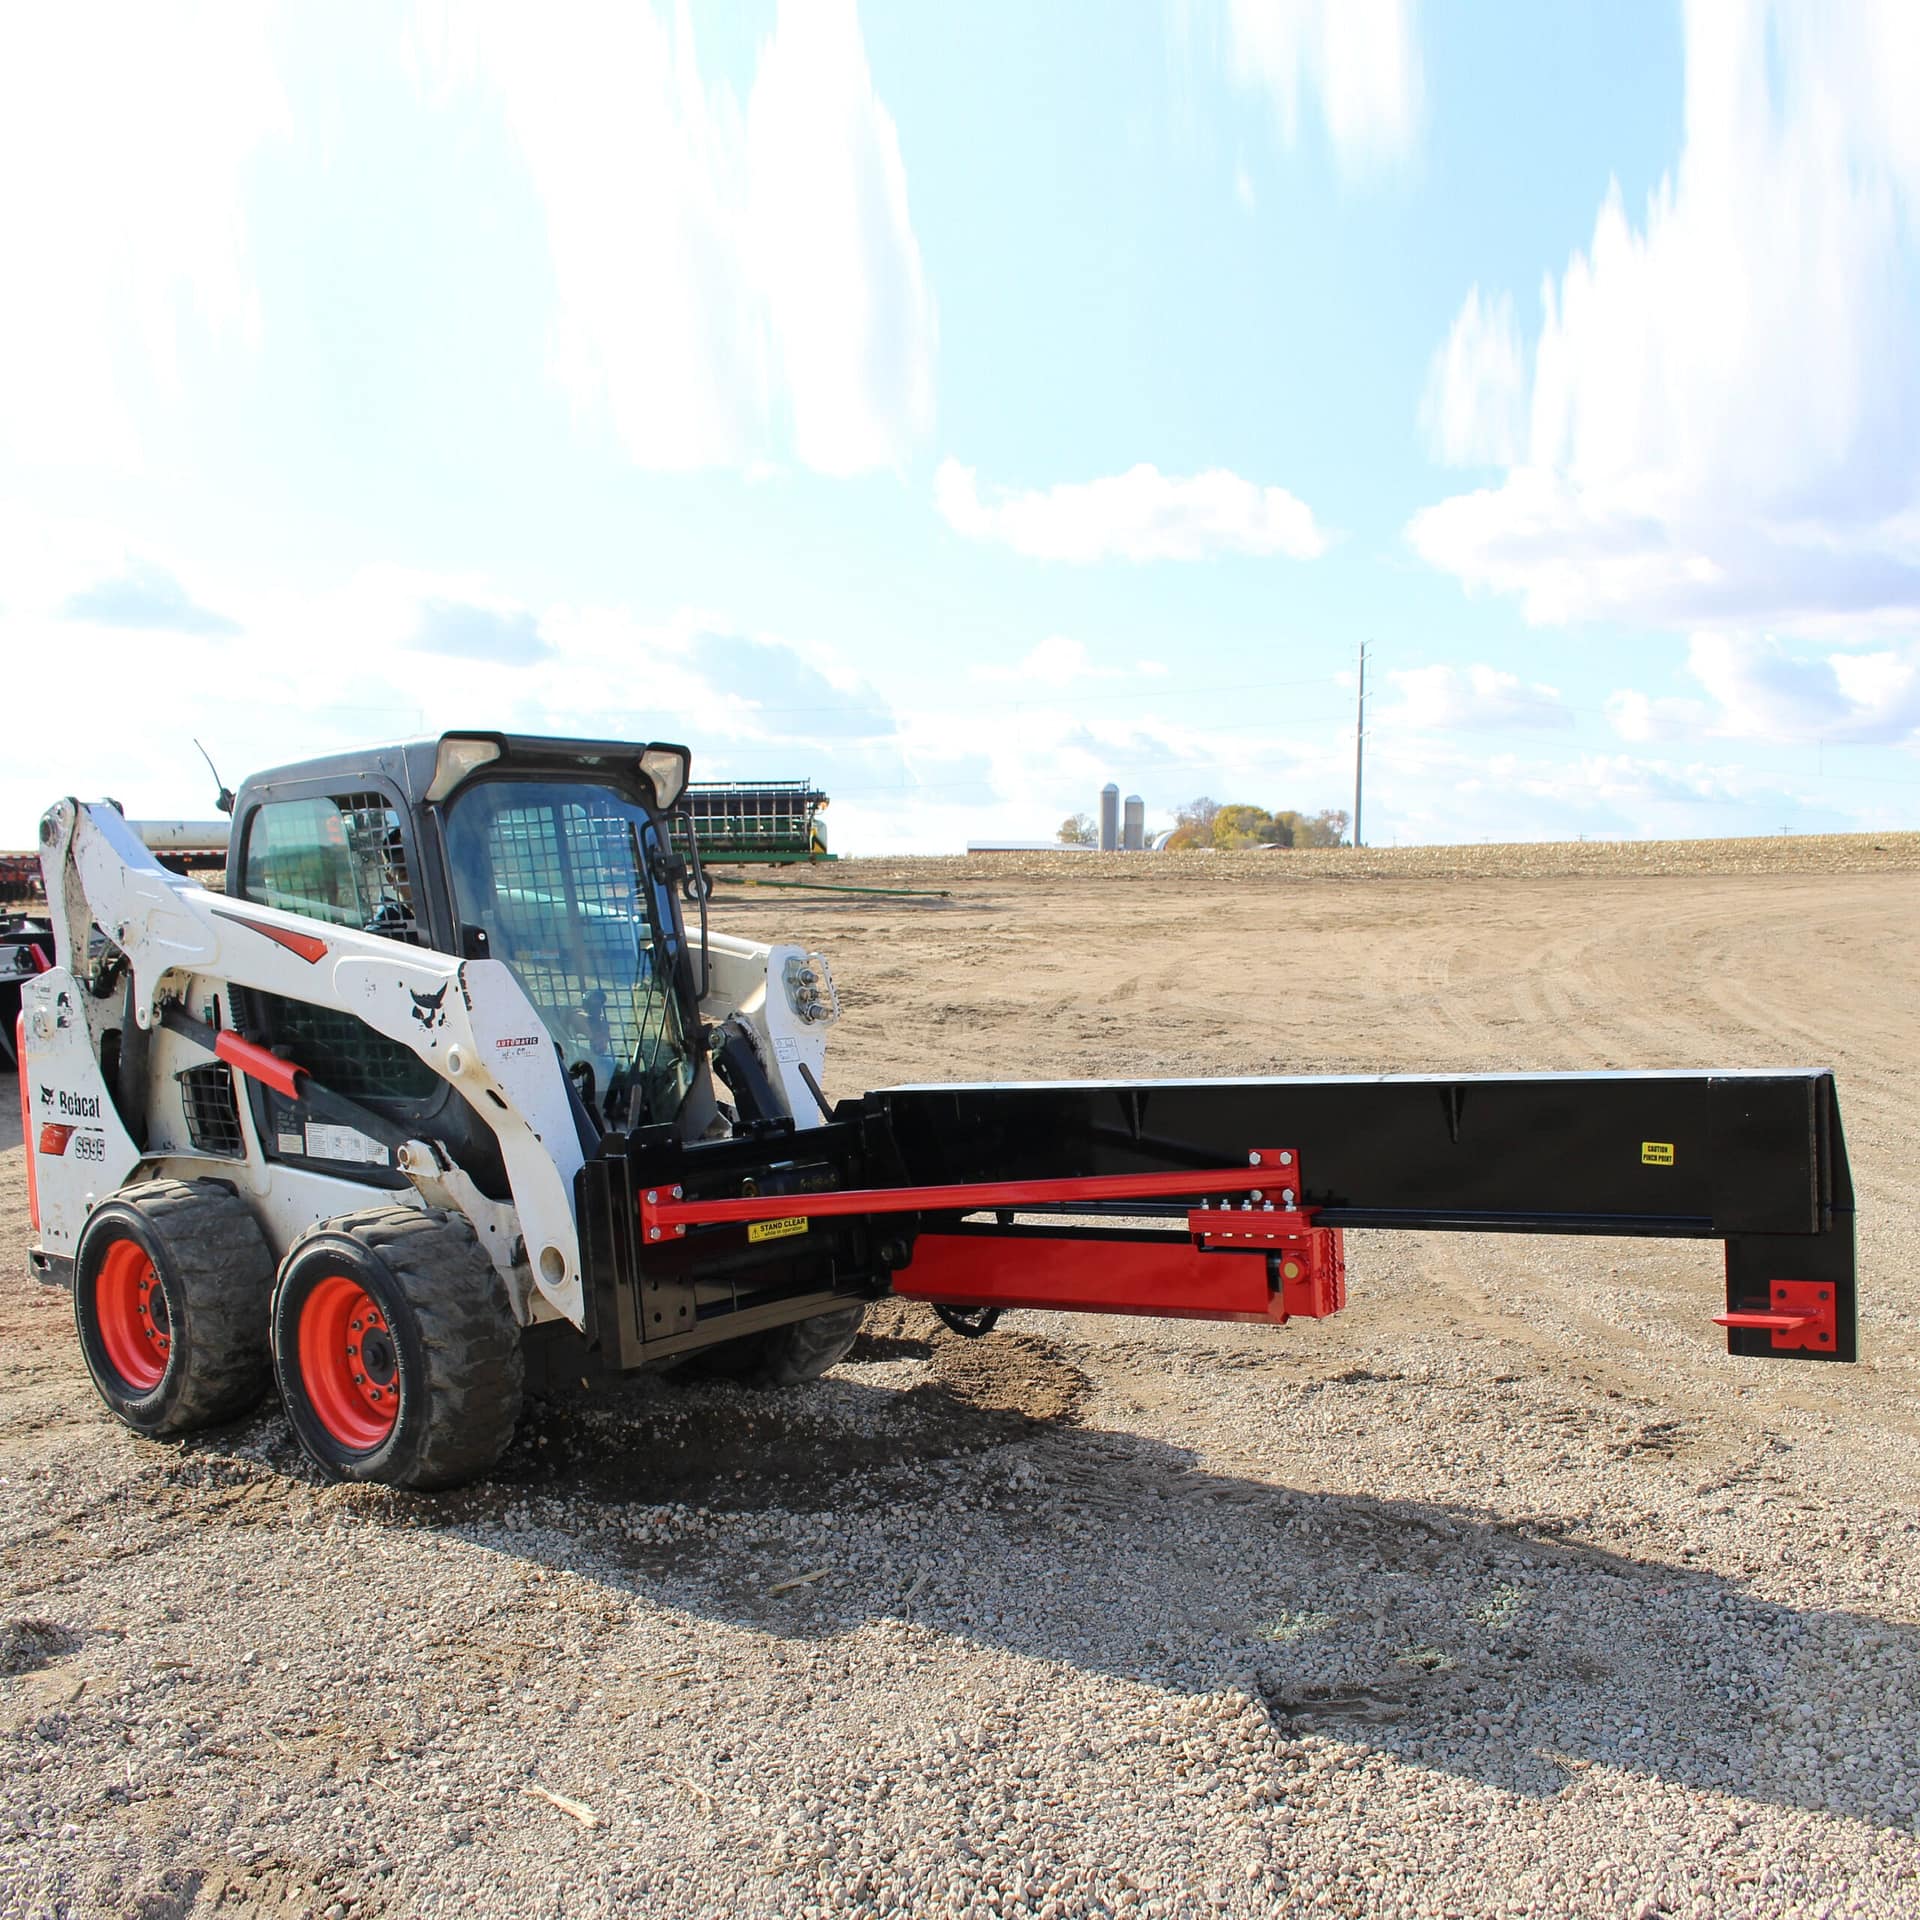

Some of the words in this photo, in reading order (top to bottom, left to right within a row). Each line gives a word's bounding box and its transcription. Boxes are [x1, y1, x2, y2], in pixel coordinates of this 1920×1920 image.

[496, 1037, 539, 1048] AUTOMATIC
[59, 1090, 100, 1118] Bobcat
[75, 1135, 105, 1162] S595
[760, 1222, 783, 1231] STAND
[784, 1218, 806, 1227] CLEAR
